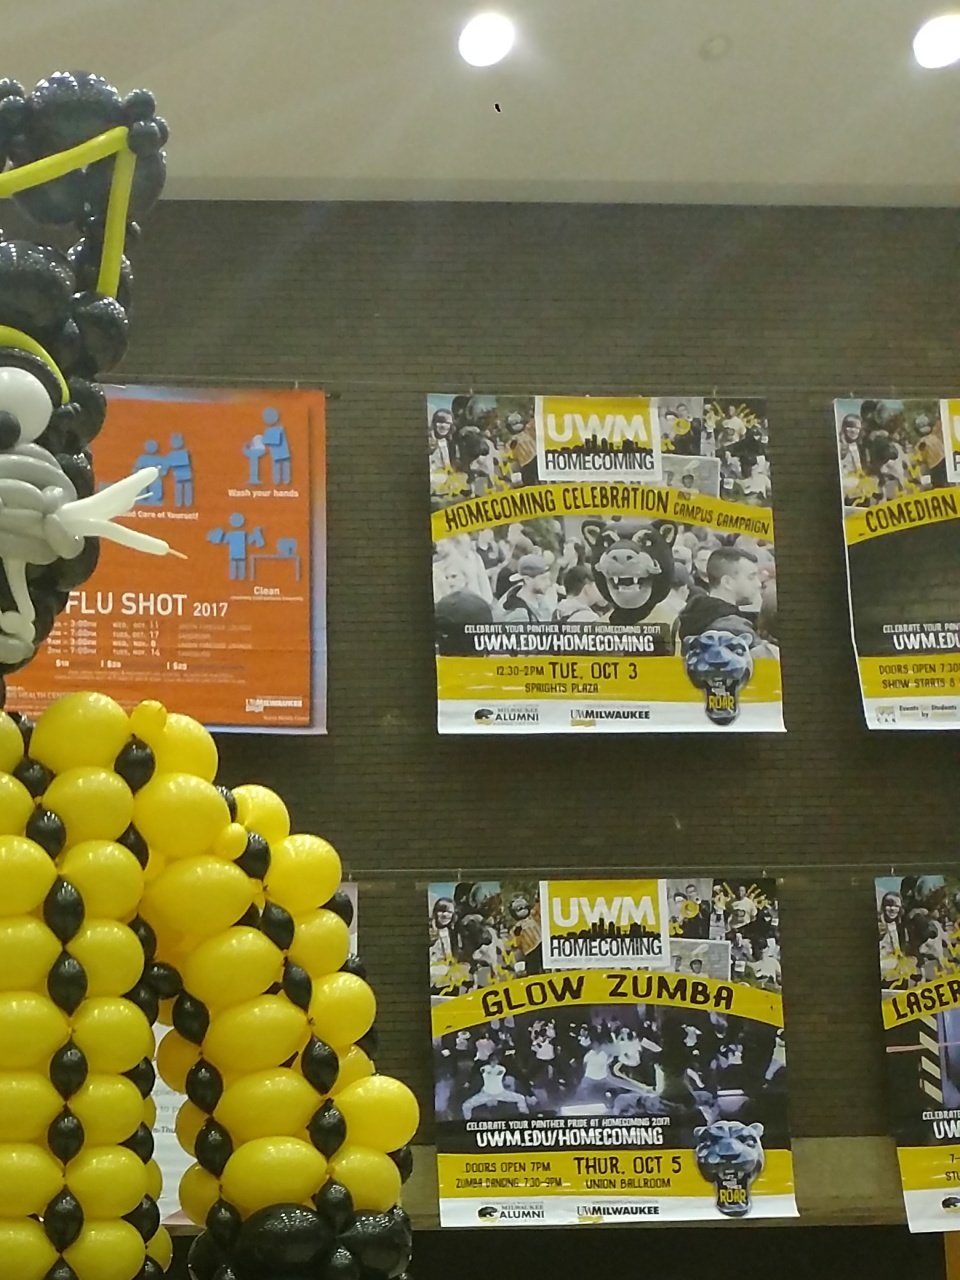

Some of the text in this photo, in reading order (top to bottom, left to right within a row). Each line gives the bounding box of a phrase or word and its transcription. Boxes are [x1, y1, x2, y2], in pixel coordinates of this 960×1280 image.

[547, 413, 648, 442] UWM
[545, 453, 654, 471] HOMECOMING
[228, 489, 299, 498] Wash your hands
[444, 486, 770, 536] HOMECOMING CELEBRATION CAMPUS CAMPAIGN
[865, 494, 958, 532] COMEDIAN
[253, 586, 280, 595] Clean
[64, 591, 228, 617] FLU SHOT 2017
[465, 625, 502, 634] CELEBRATE
[505, 625, 524, 633] YOUR
[527, 625, 559, 634] PANTHER
[562, 625, 581, 633] PRIDE
[584, 625, 593, 633] AT
[595, 625, 641, 634] HOMECOMING
[883, 624, 920, 633] CELEBRATE
[923, 623, 942, 632] YOUR
[473, 634, 654, 652] UWM.EDU/HOMECOMING
[548, 661, 583, 679] TUE.
[591, 662, 619, 679] OCT
[628, 662, 638, 680] 3
[879, 664, 908, 675] DOORS
[913, 664, 936, 673] OPEN
[571, 683, 598, 693] PLAZA
[882, 680, 910, 689] SHOW
[915, 678, 945, 689] STARTS
[709, 695, 734, 709] ROAR
[495, 712, 539, 721] ALUMNI
[552, 896, 655, 927] UWM
[549, 938, 662, 957] HOMECOMING
[481, 974, 734, 1017] GLOW ZUMBA
[893, 979, 960, 1020] LASER
[466, 1121, 506, 1131] CELEBRATE
[509, 1120, 528, 1129] YOUR
[531, 1119, 565, 1128] PANTHER
[567, 1118, 587, 1127] PRIDE
[590, 1118, 599, 1127] AT
[602, 1117, 649, 1127] HOMECOMING
[476, 1127, 663, 1148] UWM.EDU/HOMECOMING
[465, 1162, 551, 1173] DOORS OPEN 7PM
[573, 1157, 682, 1175] THUR. OCT 5
[456, 1178, 482, 1189] ZUMBA
[586, 1178, 671, 1189] UNION BALLROOM
[720, 1189, 746, 1202] ROAR
[499, 1210, 544, 1219] ALUMNI
